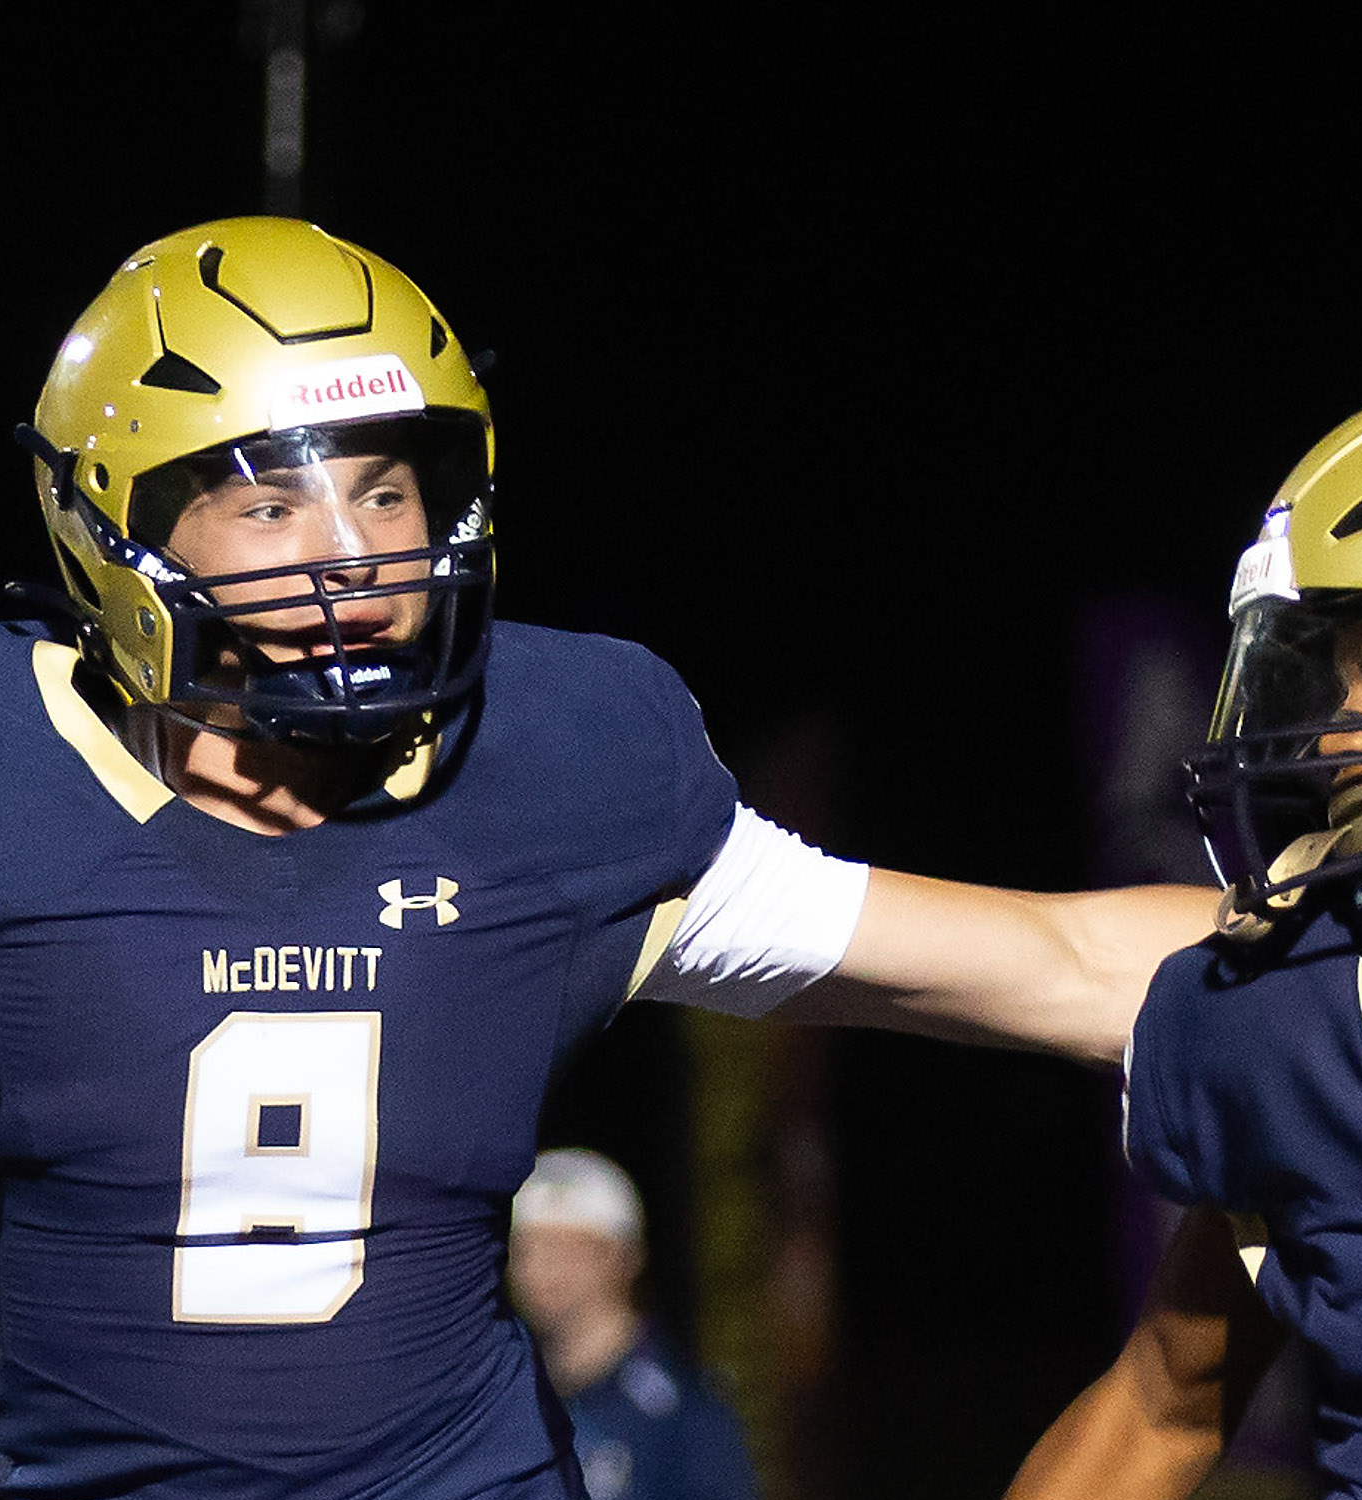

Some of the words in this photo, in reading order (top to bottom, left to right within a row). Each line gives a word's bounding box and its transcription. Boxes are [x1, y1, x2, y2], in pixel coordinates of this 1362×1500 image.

[291, 369, 407, 405] Riddell
[202, 946, 383, 993] McDEVITT
[172, 1010, 383, 1325] 8
